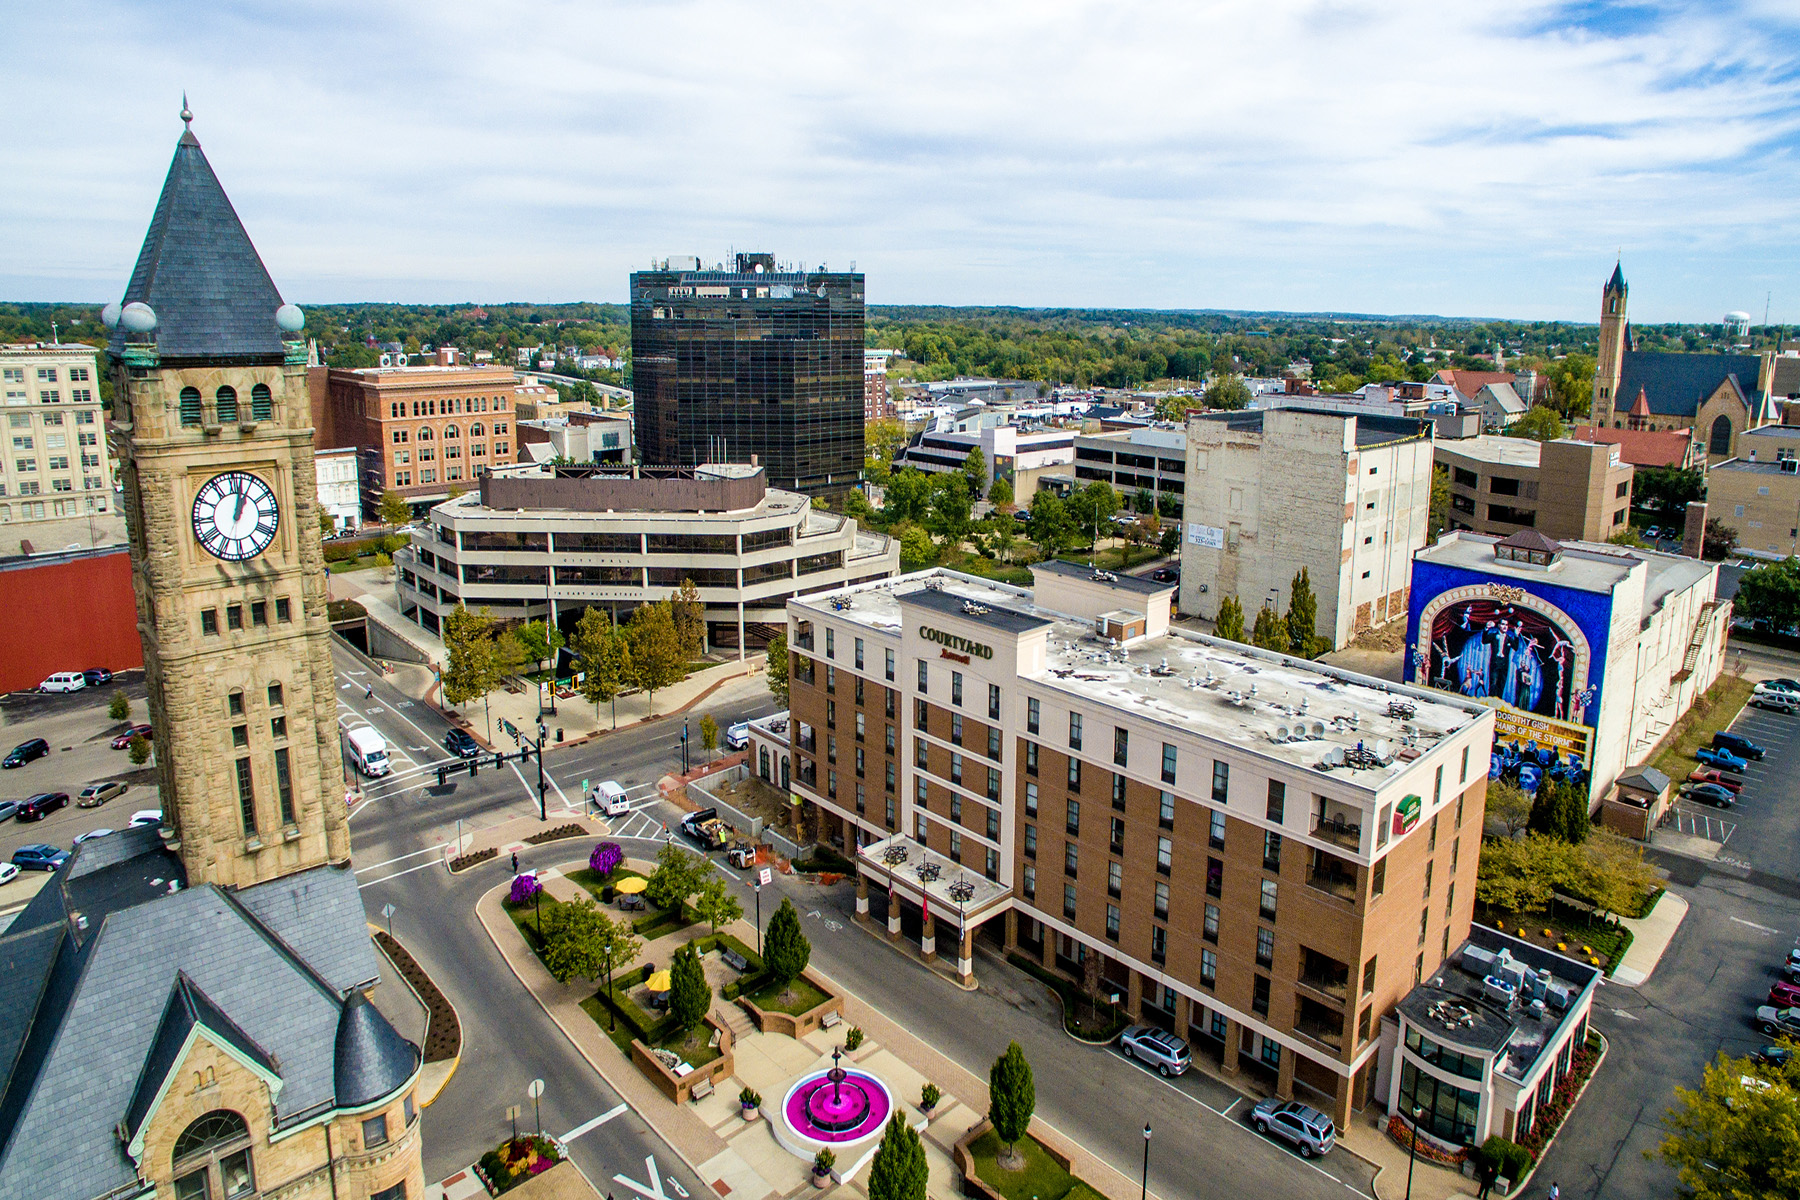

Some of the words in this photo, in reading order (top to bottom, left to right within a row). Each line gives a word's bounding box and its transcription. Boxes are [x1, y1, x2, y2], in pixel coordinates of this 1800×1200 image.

[919, 625, 993, 660] COURTYARD
[1497, 711, 1531, 726] DOROTHY
[1531, 720, 1549, 731] GISH
[1517, 726, 1528, 735] OF
[1528, 729, 1543, 740] THE
